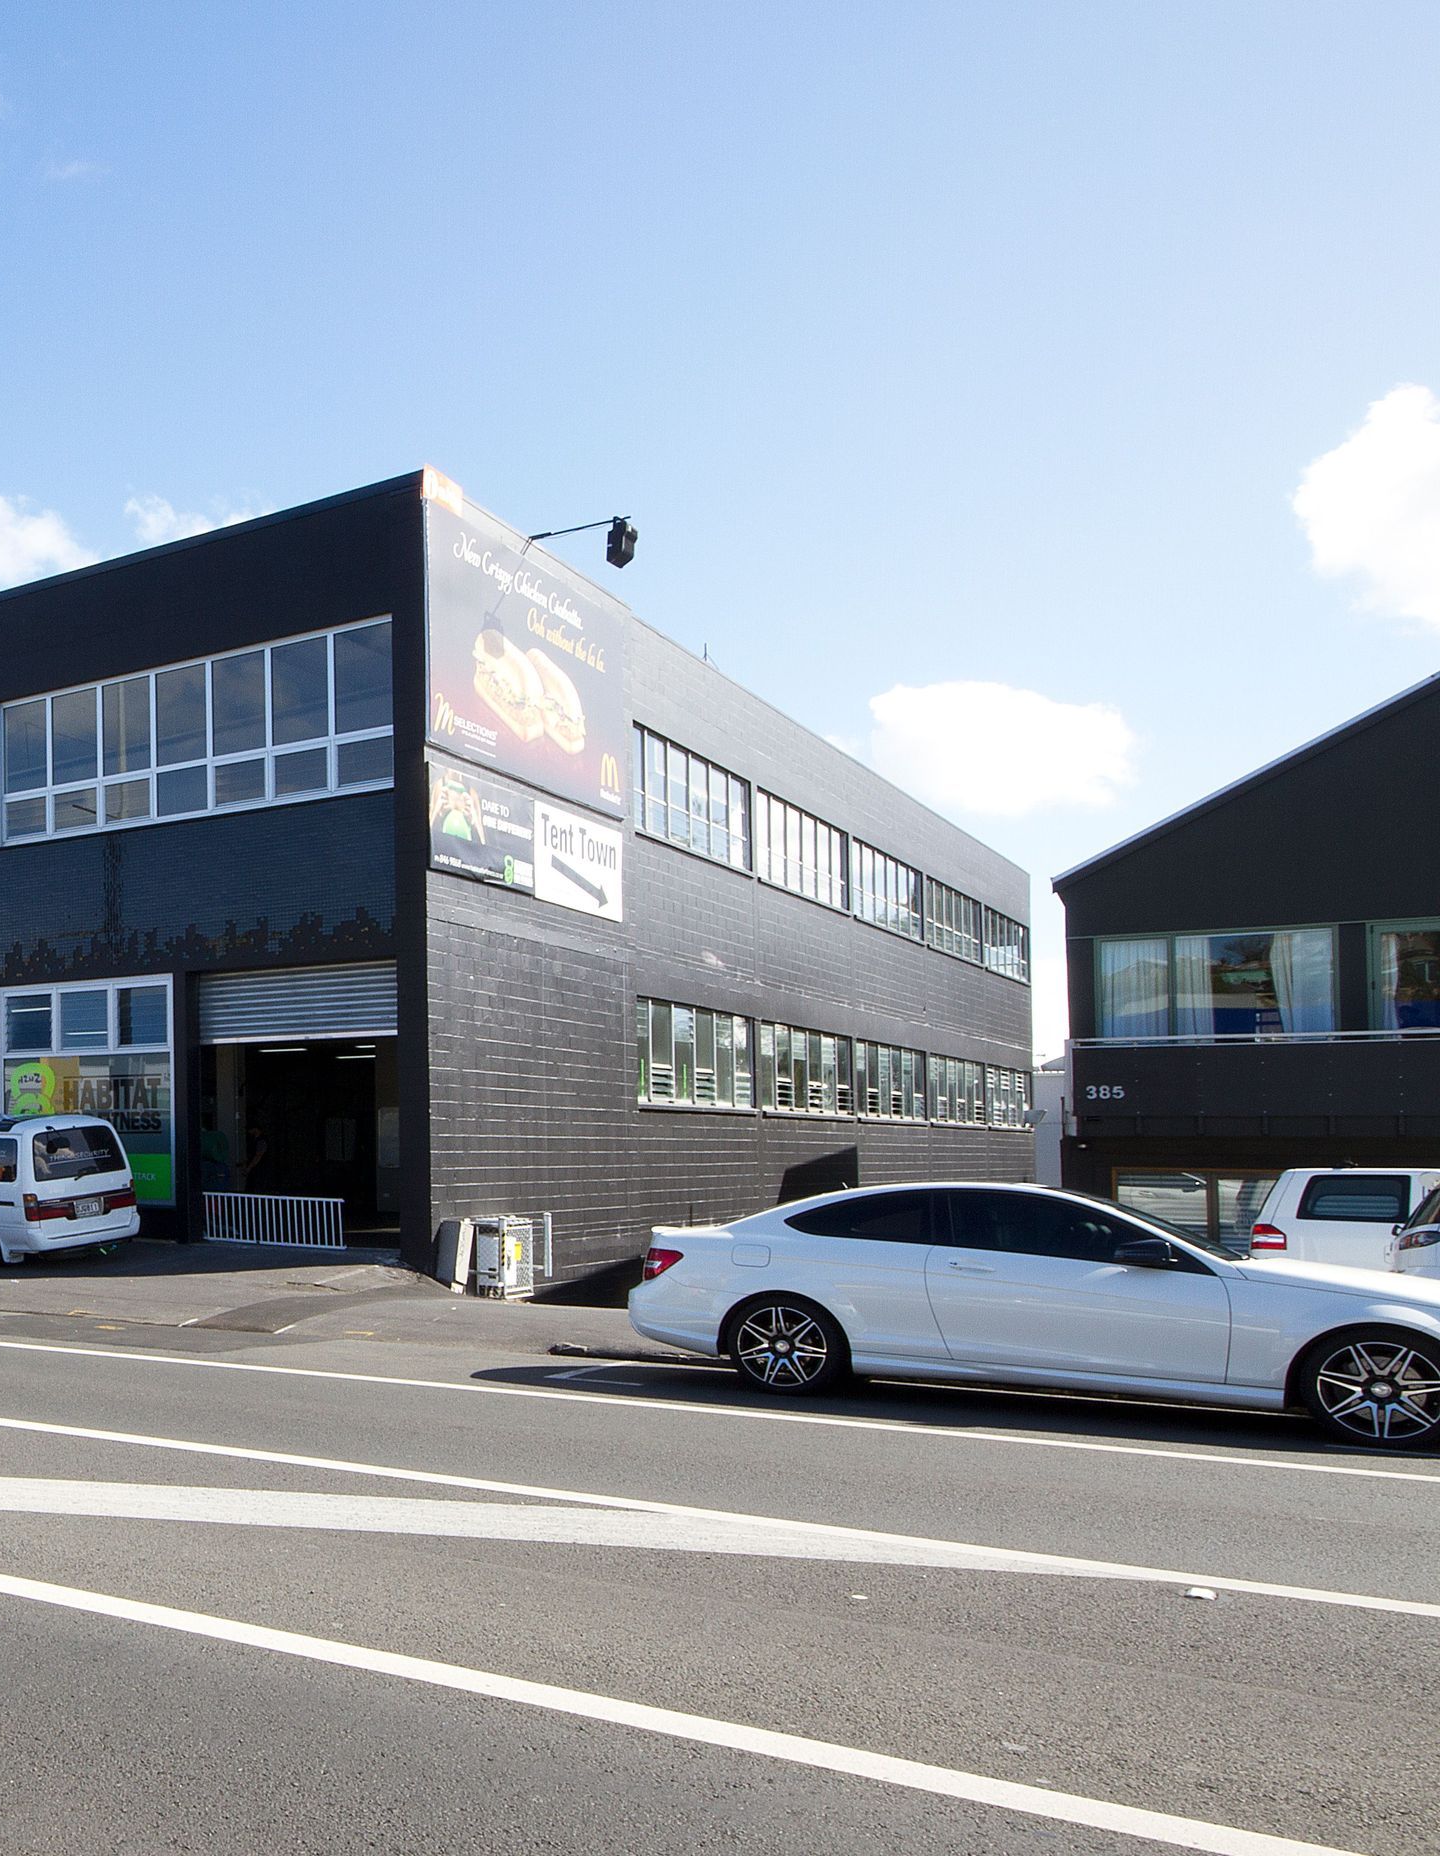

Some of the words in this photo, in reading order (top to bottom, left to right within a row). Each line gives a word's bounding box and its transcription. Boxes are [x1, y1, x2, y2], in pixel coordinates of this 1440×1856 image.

[453, 532, 481, 567] New
[482, 551, 513, 595] Crispy
[514, 571, 547, 608] Chicken
[527, 608, 547, 637] Ooh
[546, 625, 574, 655] without
[575, 637, 586, 661] the
[541, 812, 573, 856] Tent
[579, 827, 616, 870] Town
[63, 1078, 161, 1110] HABITAT
[1085, 1085, 1125, 1099] 385
